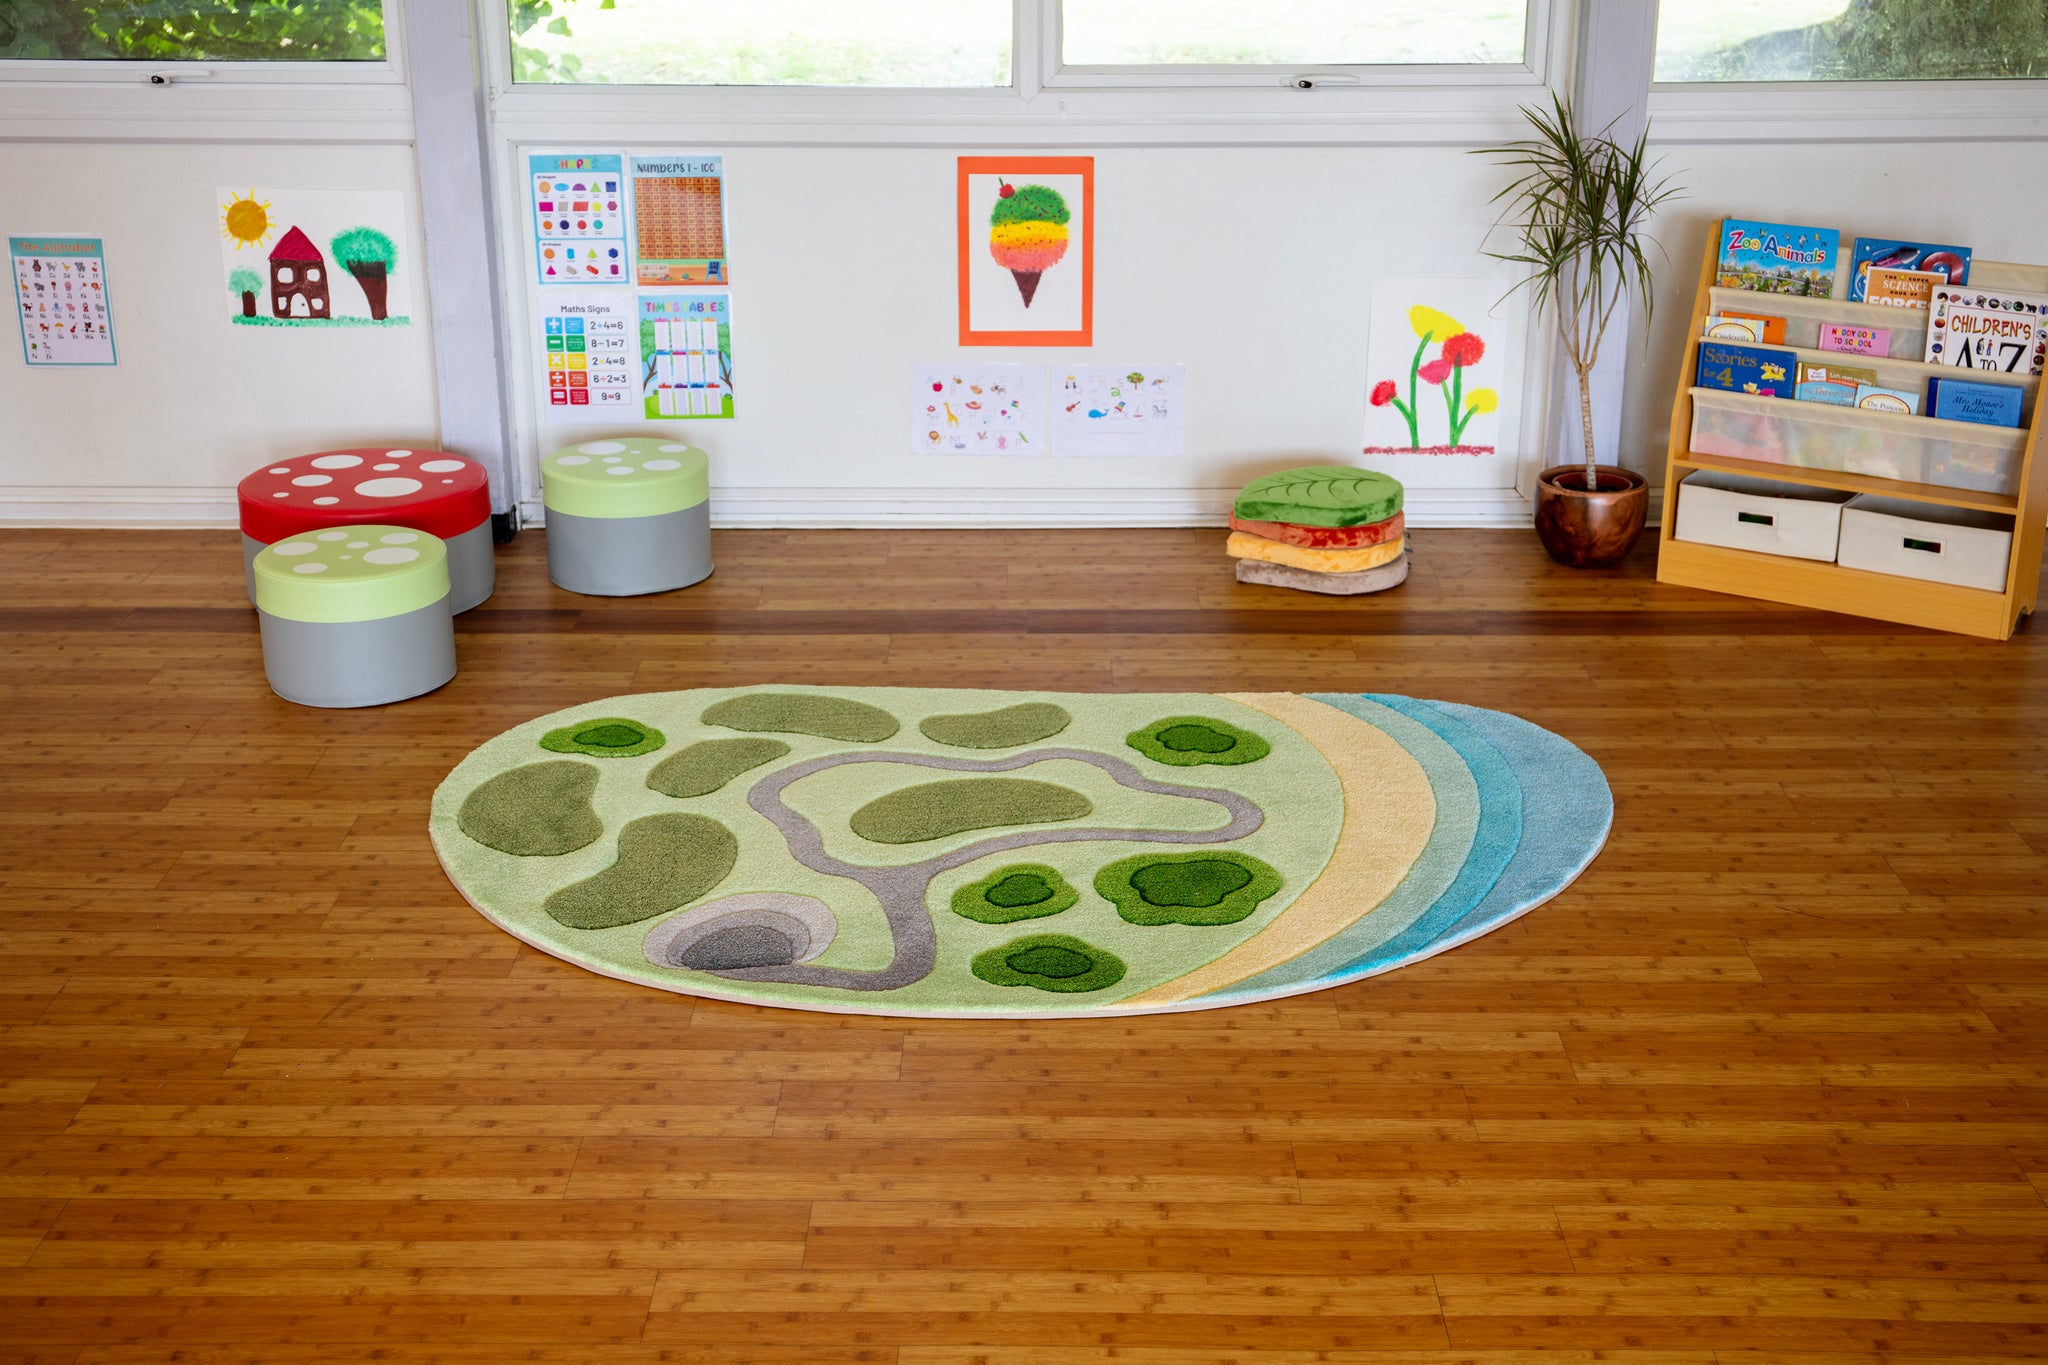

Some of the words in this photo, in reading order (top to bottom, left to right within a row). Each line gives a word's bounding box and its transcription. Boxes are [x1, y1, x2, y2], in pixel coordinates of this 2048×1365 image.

[554, 158, 598, 169] SHAPES
[637, 164, 685, 173] Numbers
[687, 164, 690, 172] 1
[701, 163, 715, 172] 100
[19, 242, 39, 251] The
[43, 243, 95, 253] Alphabet
[1728, 230, 1761, 250] Zoo
[1763, 235, 1826, 264] Animals
[1883, 280, 1928, 293] SCIENCE
[646, 302, 679, 312] TIMES
[684, 302, 725, 312] TABLES
[1869, 296, 1931, 309] FORCE
[587, 305, 610, 314] Signs
[1952, 315, 2032, 340] CHILDREN'S
[1844, 338, 1872, 348] SCHOOL
[1704, 348, 1757, 368] Stories
[1956, 337, 1972, 368] A
[1980, 359, 1997, 371] TO
[1999, 342, 2027, 372] Z
[1716, 368, 1733, 387] 4
[1814, 387, 1839, 398] Three
[1840, 391, 1855, 399] Bill
[1952, 396, 1970, 404] Mrs
[1972, 398, 2005, 409] Mouse's
[1962, 404, 1994, 417] Holiday
